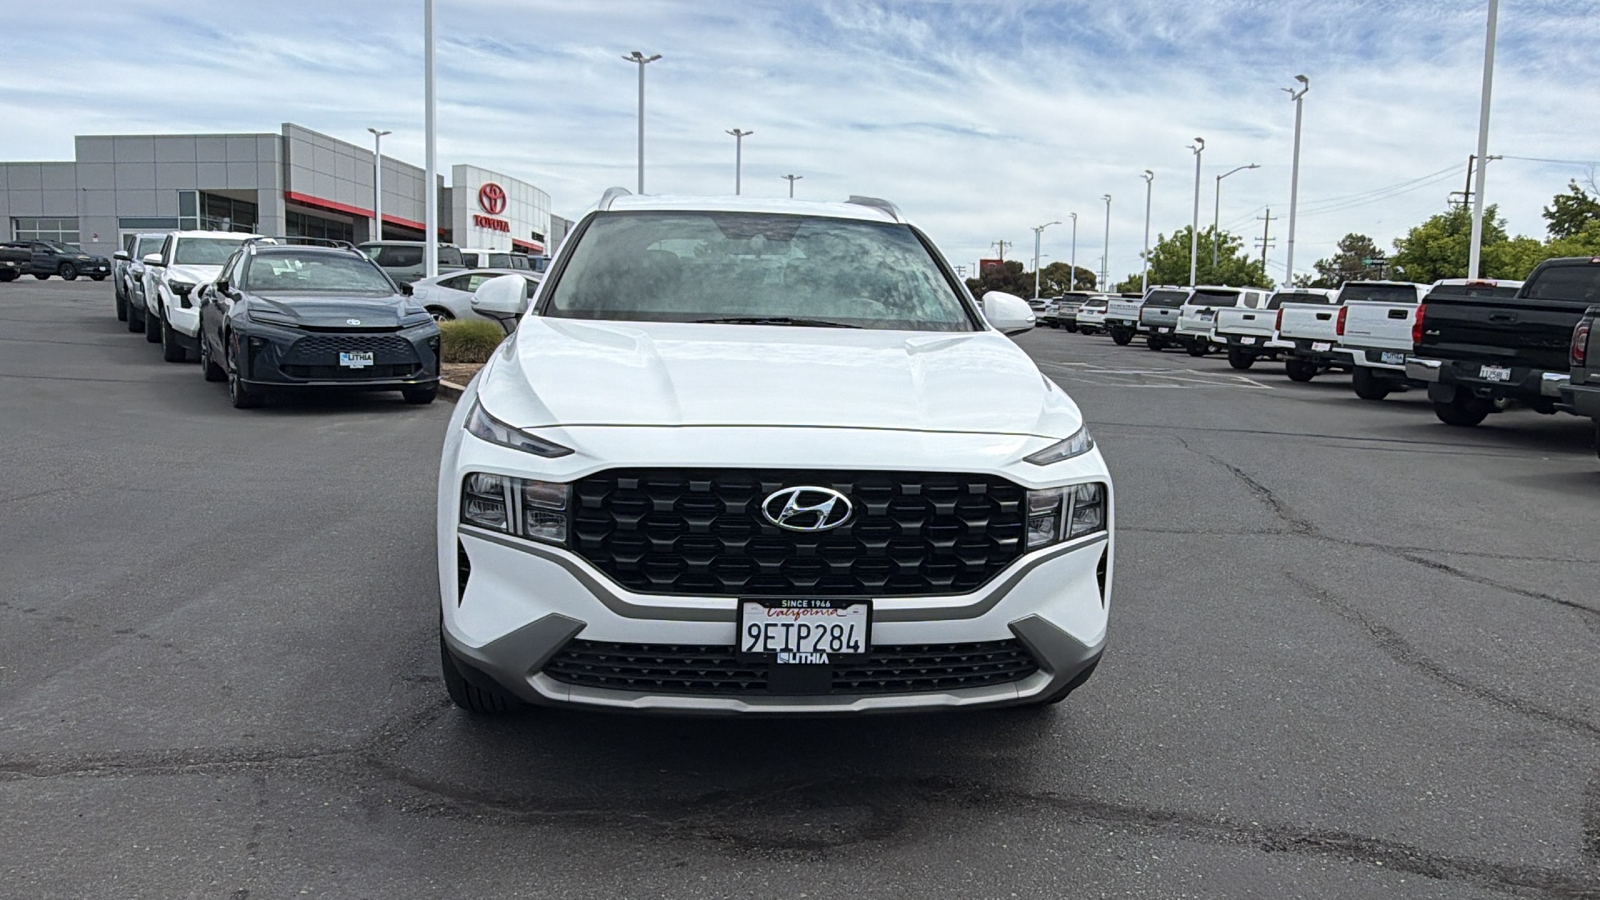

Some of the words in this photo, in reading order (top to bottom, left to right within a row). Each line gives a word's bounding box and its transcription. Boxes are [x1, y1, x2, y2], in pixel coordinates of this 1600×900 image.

[473, 214, 510, 233] TOYOTA
[811, 600, 831, 608] 1946
[746, 622, 861, 653] 9EIP284
[789, 652, 829, 664] LITHIA
